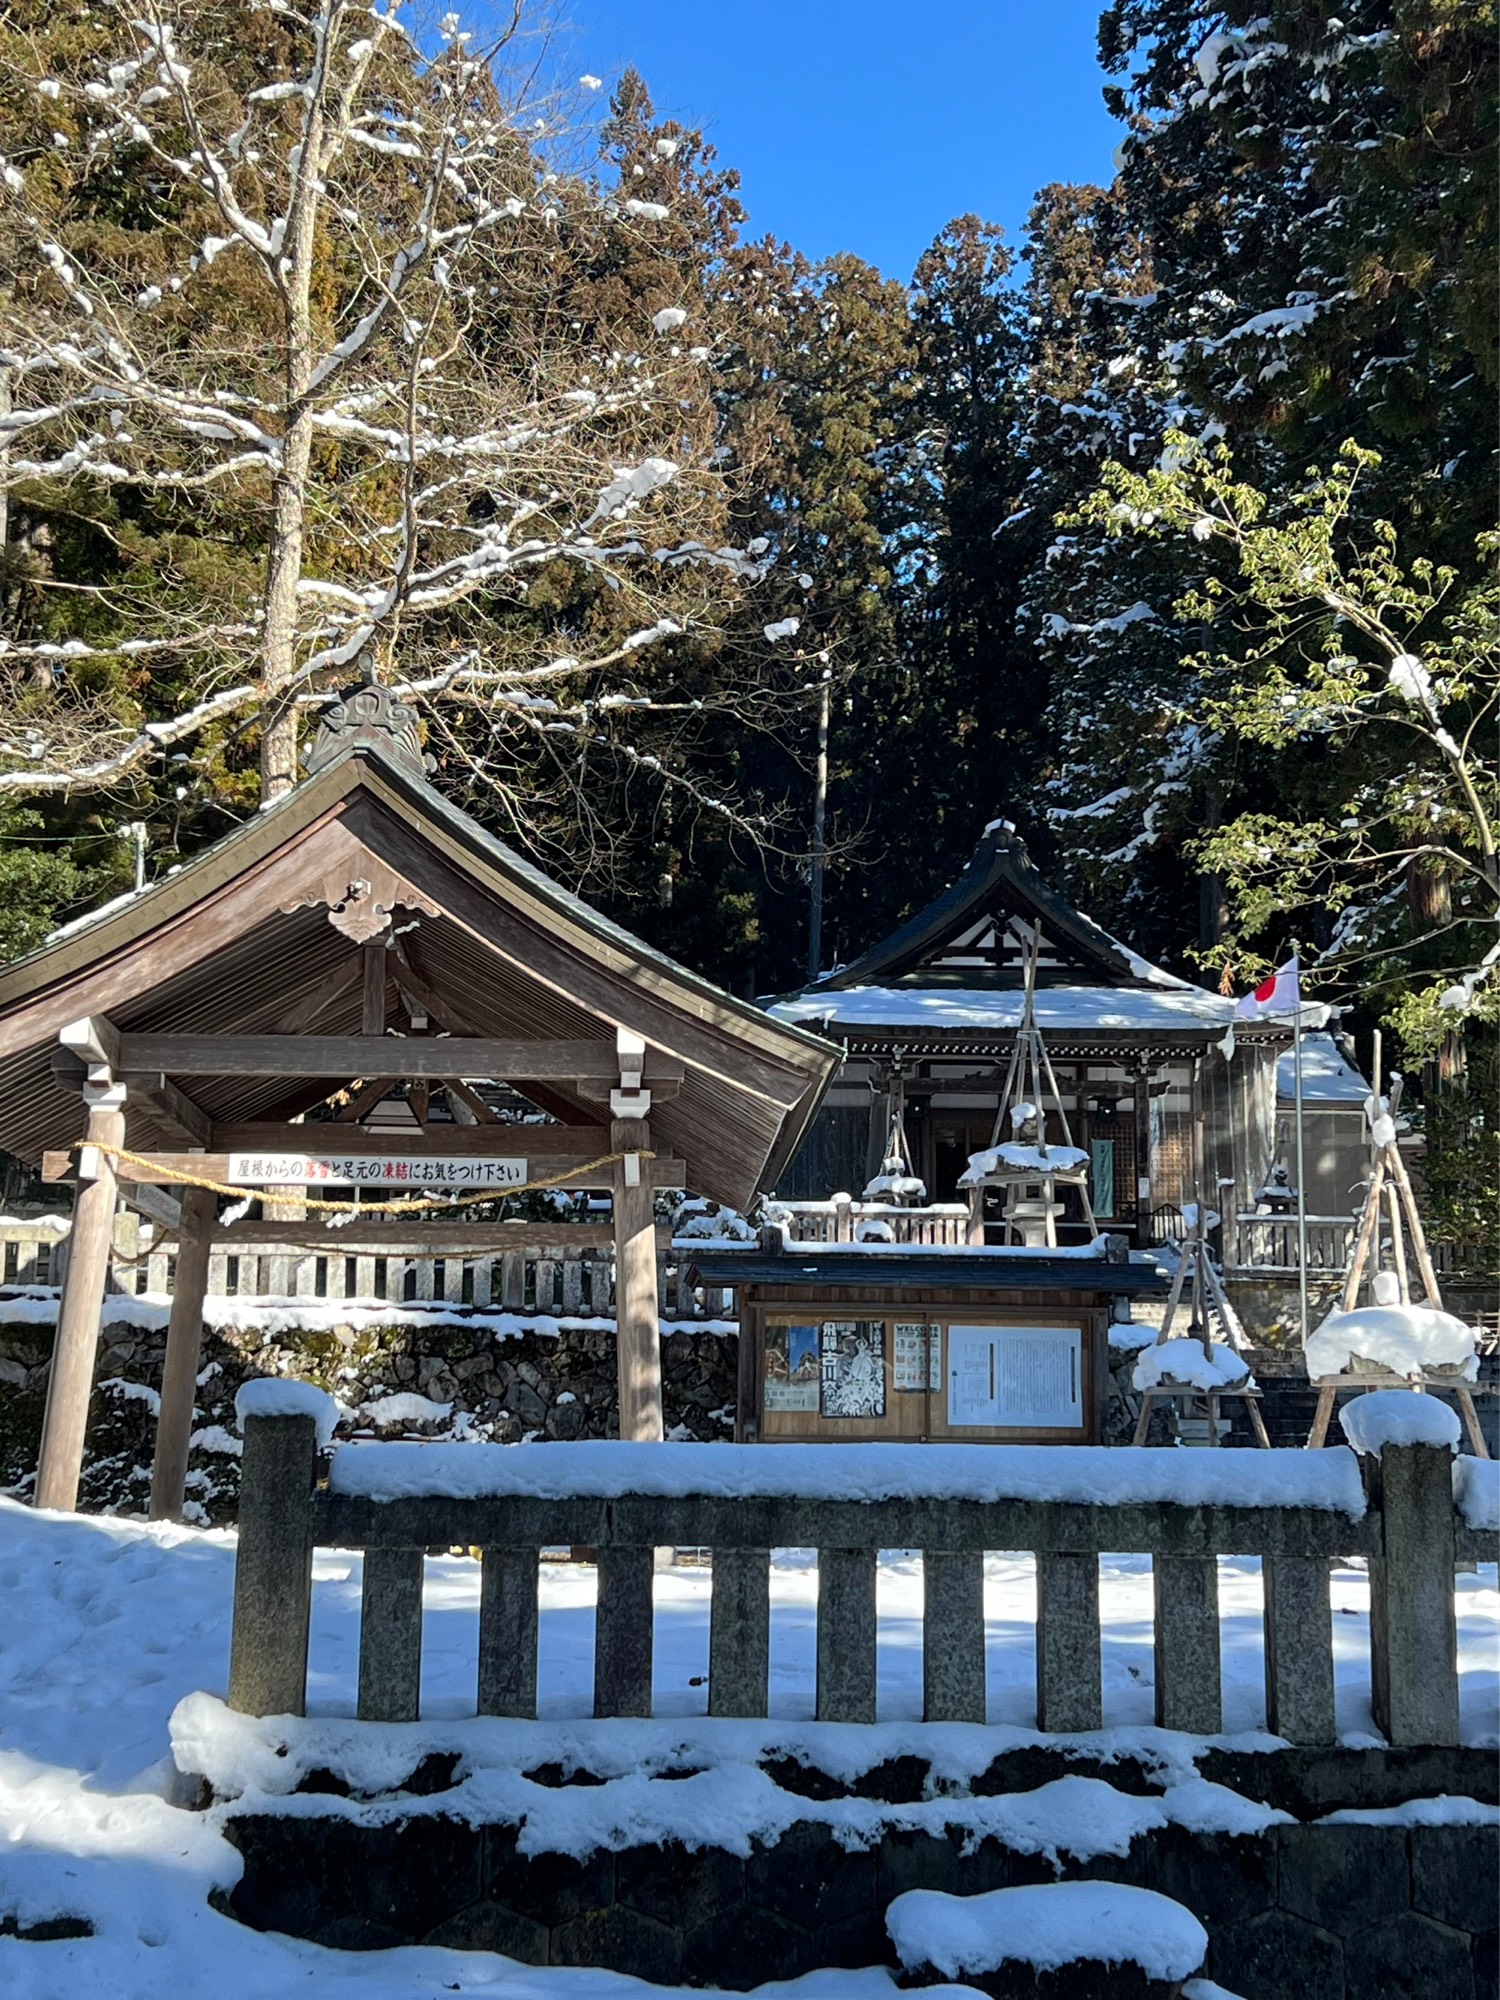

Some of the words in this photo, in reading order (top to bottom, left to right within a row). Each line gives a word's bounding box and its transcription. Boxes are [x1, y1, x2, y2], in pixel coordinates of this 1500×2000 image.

[238, 1160, 520, 1181] 屋根からの落雪と足元の凍結にお気をつけ下さい
